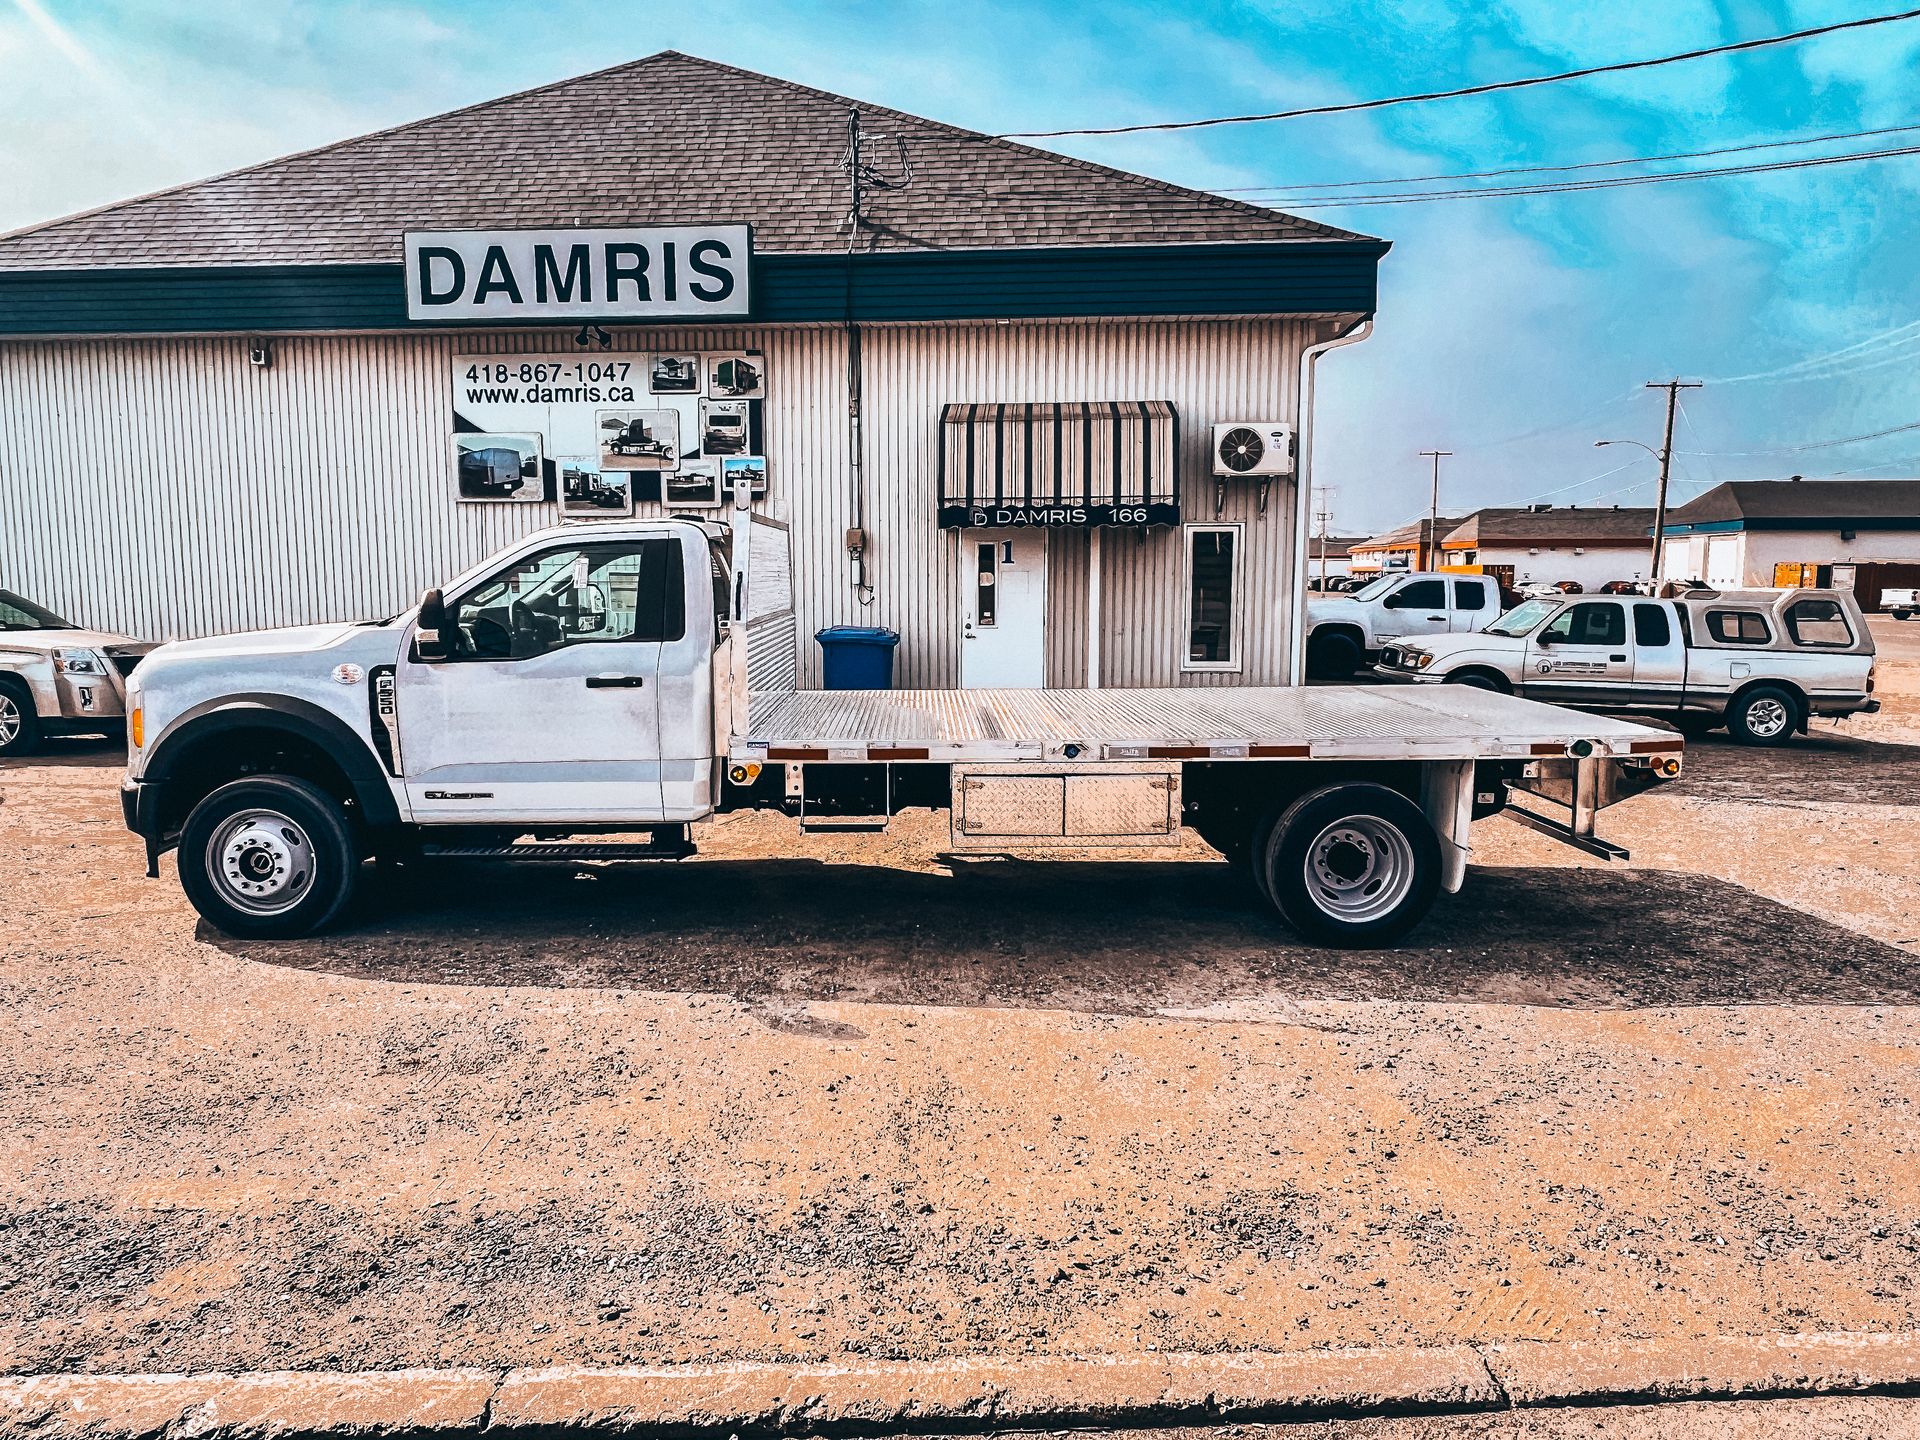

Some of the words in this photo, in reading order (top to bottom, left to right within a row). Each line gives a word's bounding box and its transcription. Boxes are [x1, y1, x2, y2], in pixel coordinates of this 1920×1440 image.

[418, 239, 735, 306] DAMRIS
[465, 362, 632, 384] 418-867-1047
[466, 382, 635, 404] www.damris.ca
[996, 508, 1087, 524] DAMRIS
[1108, 508, 1147, 523] 166
[1001, 540, 1015, 564] 1
